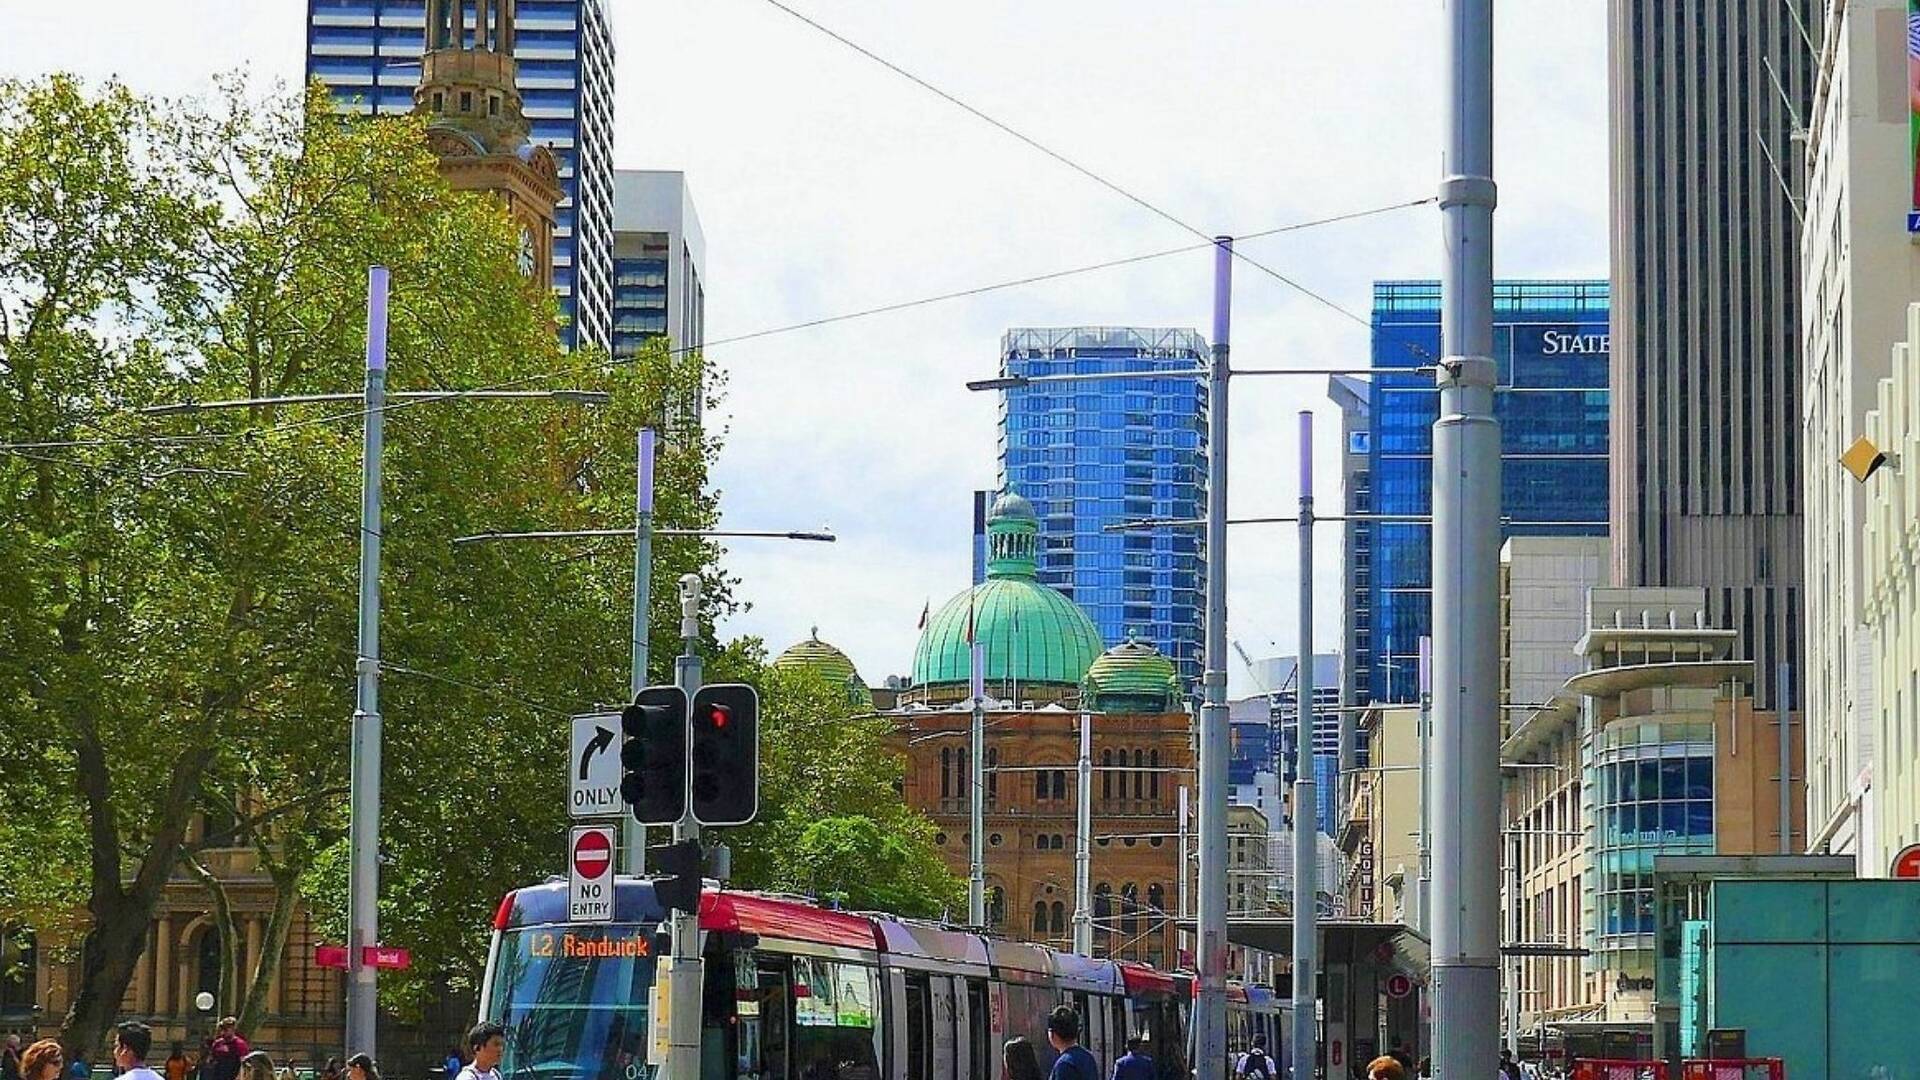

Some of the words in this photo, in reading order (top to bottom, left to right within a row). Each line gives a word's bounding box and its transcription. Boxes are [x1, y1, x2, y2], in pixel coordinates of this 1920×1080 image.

[573, 787, 618, 806] ONLY
[581, 884, 601, 898] NO
[572, 902, 609, 915] ENTRY
[531, 933, 554, 957] L2
[563, 933, 648, 957] Randwick
